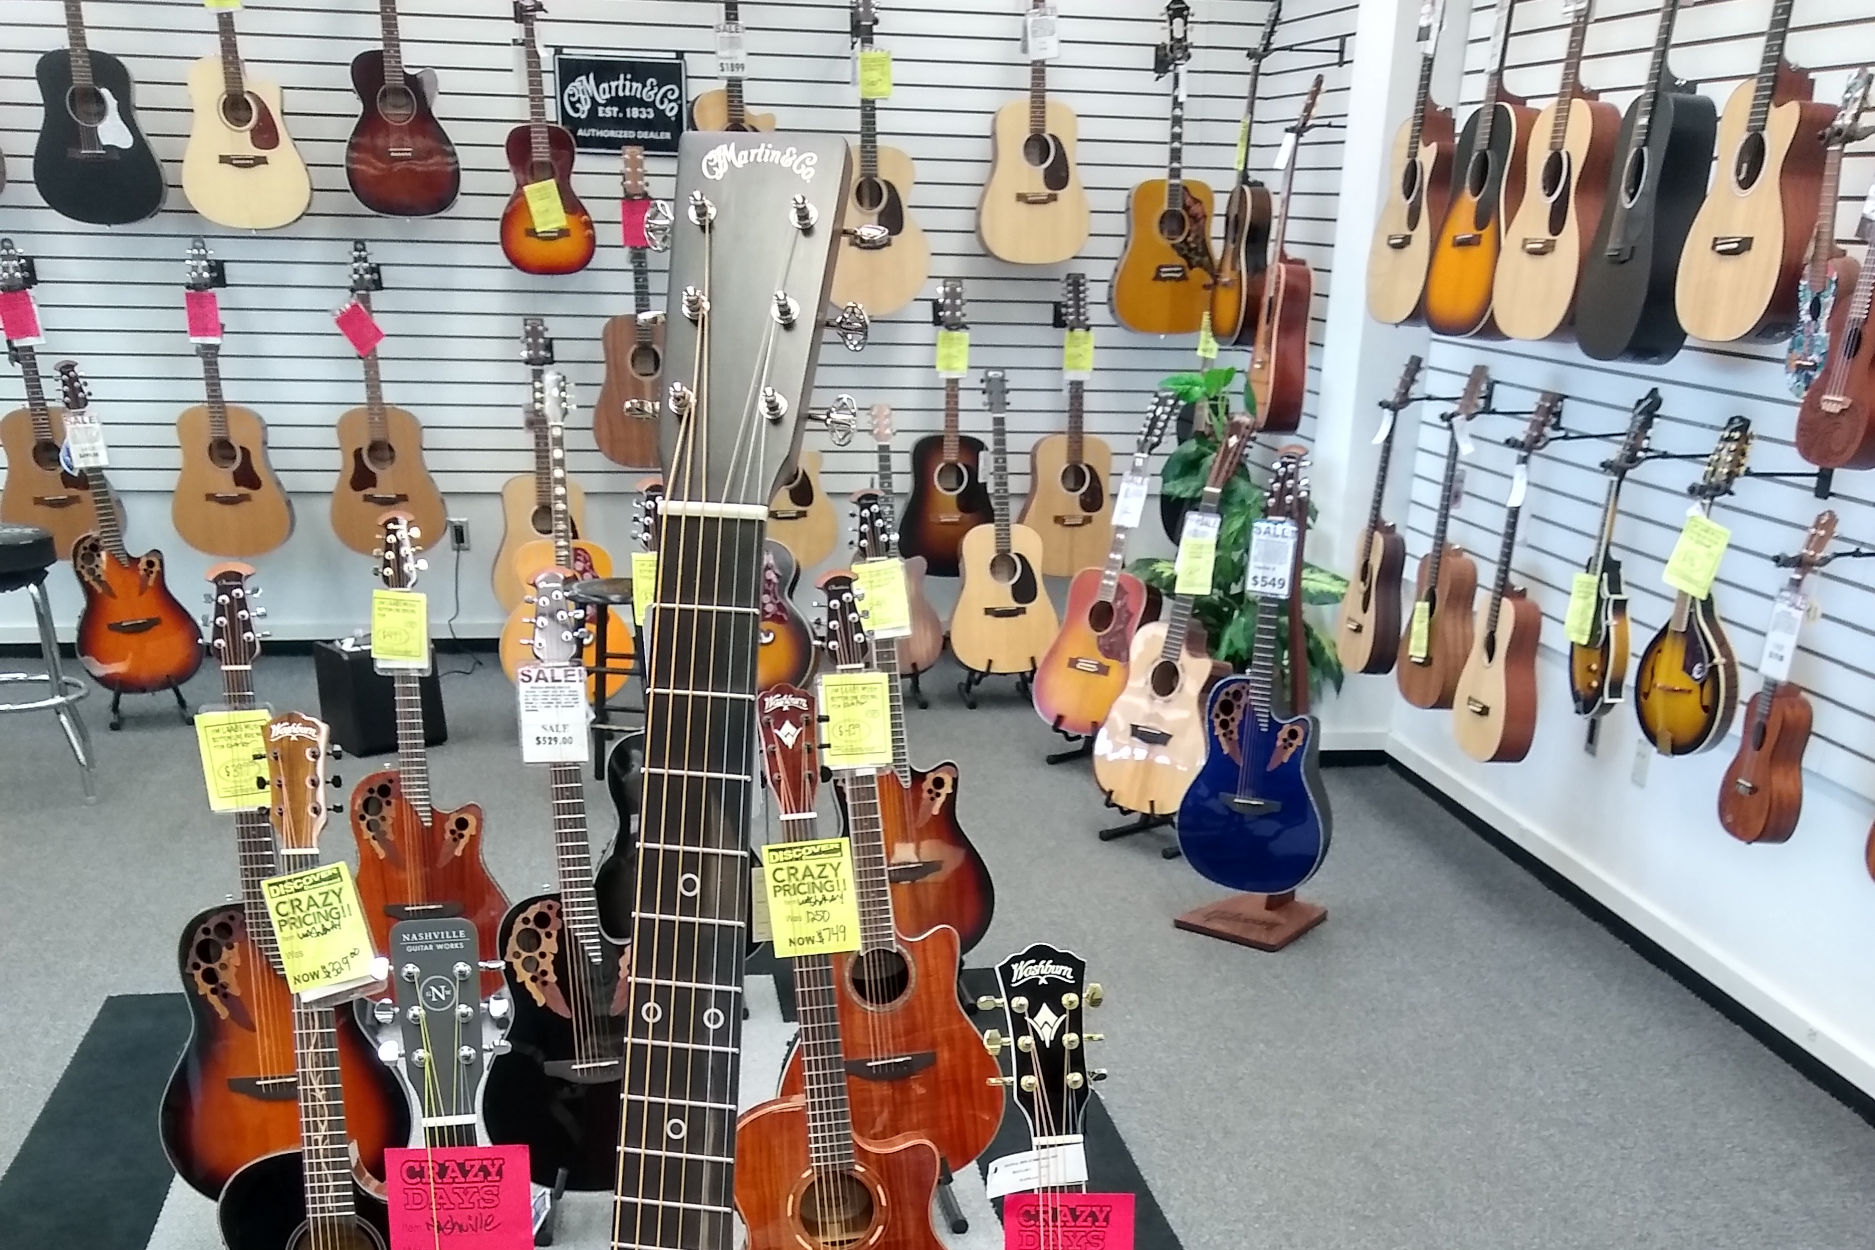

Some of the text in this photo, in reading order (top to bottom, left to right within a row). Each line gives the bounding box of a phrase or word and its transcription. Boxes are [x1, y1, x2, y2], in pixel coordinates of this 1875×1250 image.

[598, 106, 655, 119] EST. 1833
[576, 127, 672, 140] AUTHORIZED DEALER
[1252, 575, 1286, 589] $549
[520, 668, 585, 684] SALE!
[541, 724, 570, 733] SALE
[535, 736, 574, 746] $529.00
[772, 862, 842, 883] CRAZY
[773, 878, 847, 898] PRICING!!
[275, 887, 343, 917] CRAZY
[278, 904, 352, 933] PRICING!!
[402, 930, 467, 942] NASHVILLE
[789, 936, 815, 947] NOW
[406, 942, 465, 952] GUITAR WORKS
[293, 969, 320, 986] NOW
[1011, 960, 1075, 983] Washburn
[401, 1158, 505, 1186] CRAZY
[403, 1185, 501, 1211] DAYS
[1017, 1205, 1113, 1228] CRAZY
